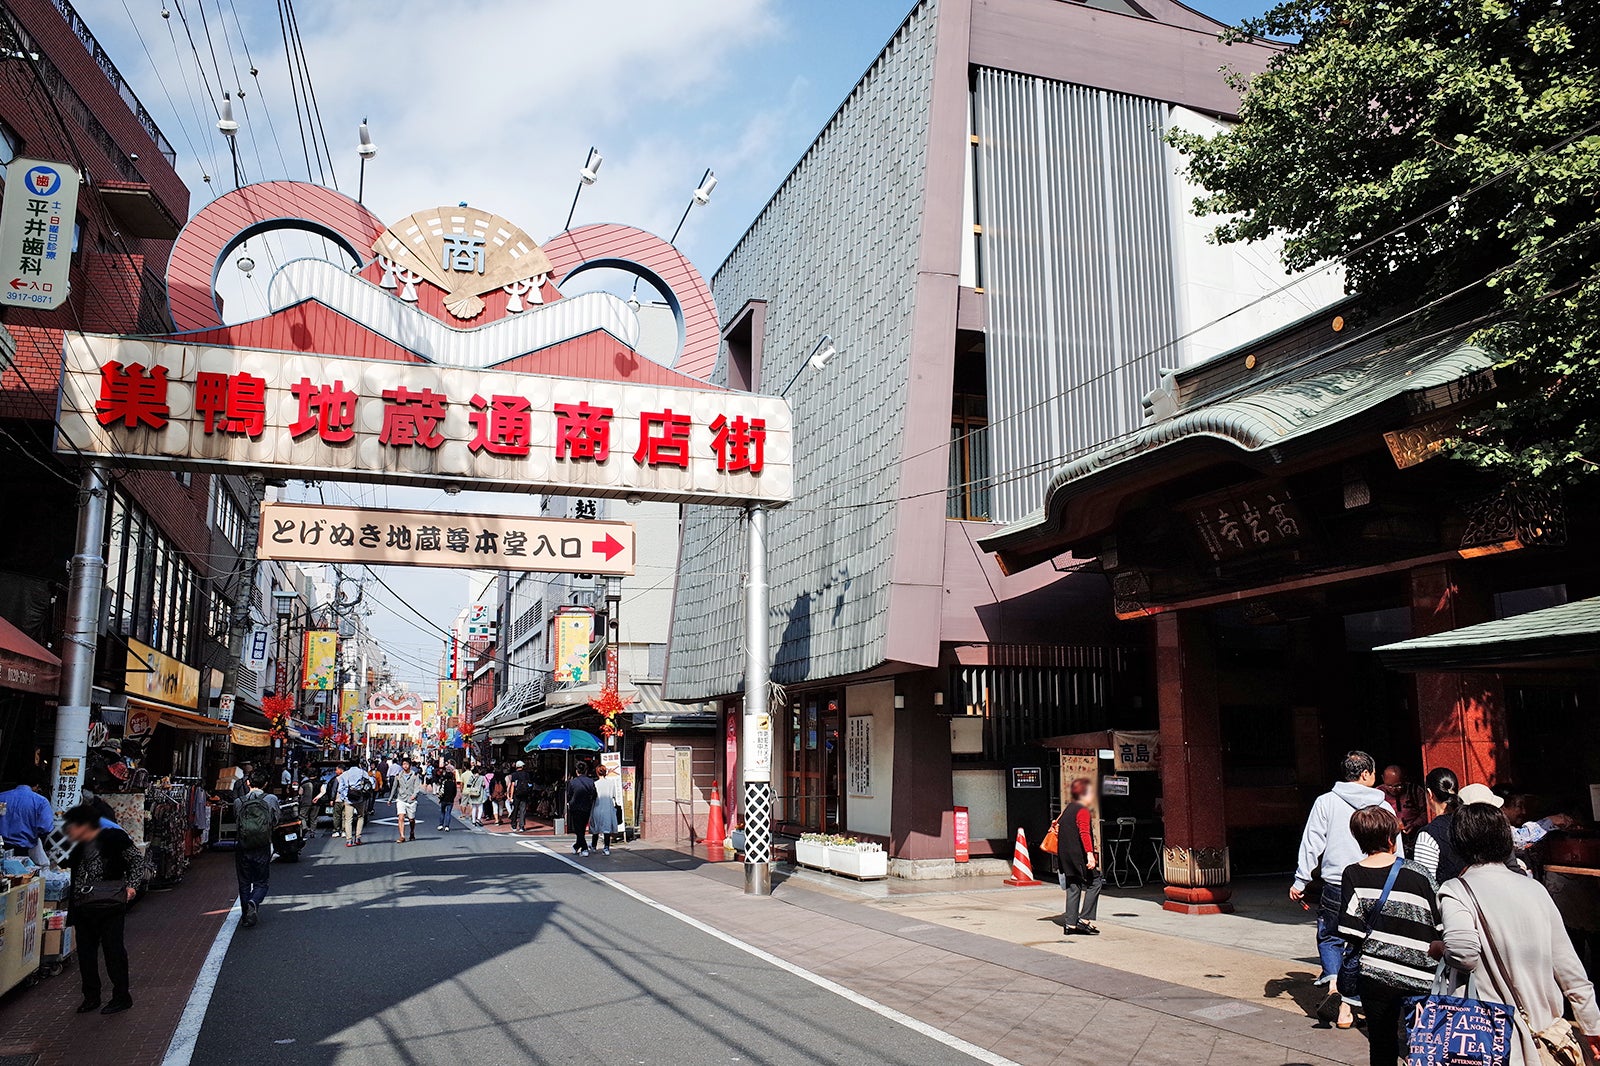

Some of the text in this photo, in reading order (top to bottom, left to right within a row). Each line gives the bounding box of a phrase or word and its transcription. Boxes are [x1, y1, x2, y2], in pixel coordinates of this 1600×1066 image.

[36, 175, 49, 187] 歯
[19, 199, 48, 276] 平井歯科
[442, 232, 486, 275] 商
[30, 281, 52, 292] 入口
[7, 292, 52, 303] 3917-0871
[95, 360, 767, 474] 巣鴨地蔵通商店街
[272, 519, 582, 560] とげぬき地蔵尊本堂入口
[65, 776, 77, 809] 防犯カメ
[1473, 1005, 1491, 1016] TEA
[1417, 1032, 1443, 1045] TEA
[1470, 1024, 1493, 1034] NOON
[1451, 1031, 1487, 1057] TEA
